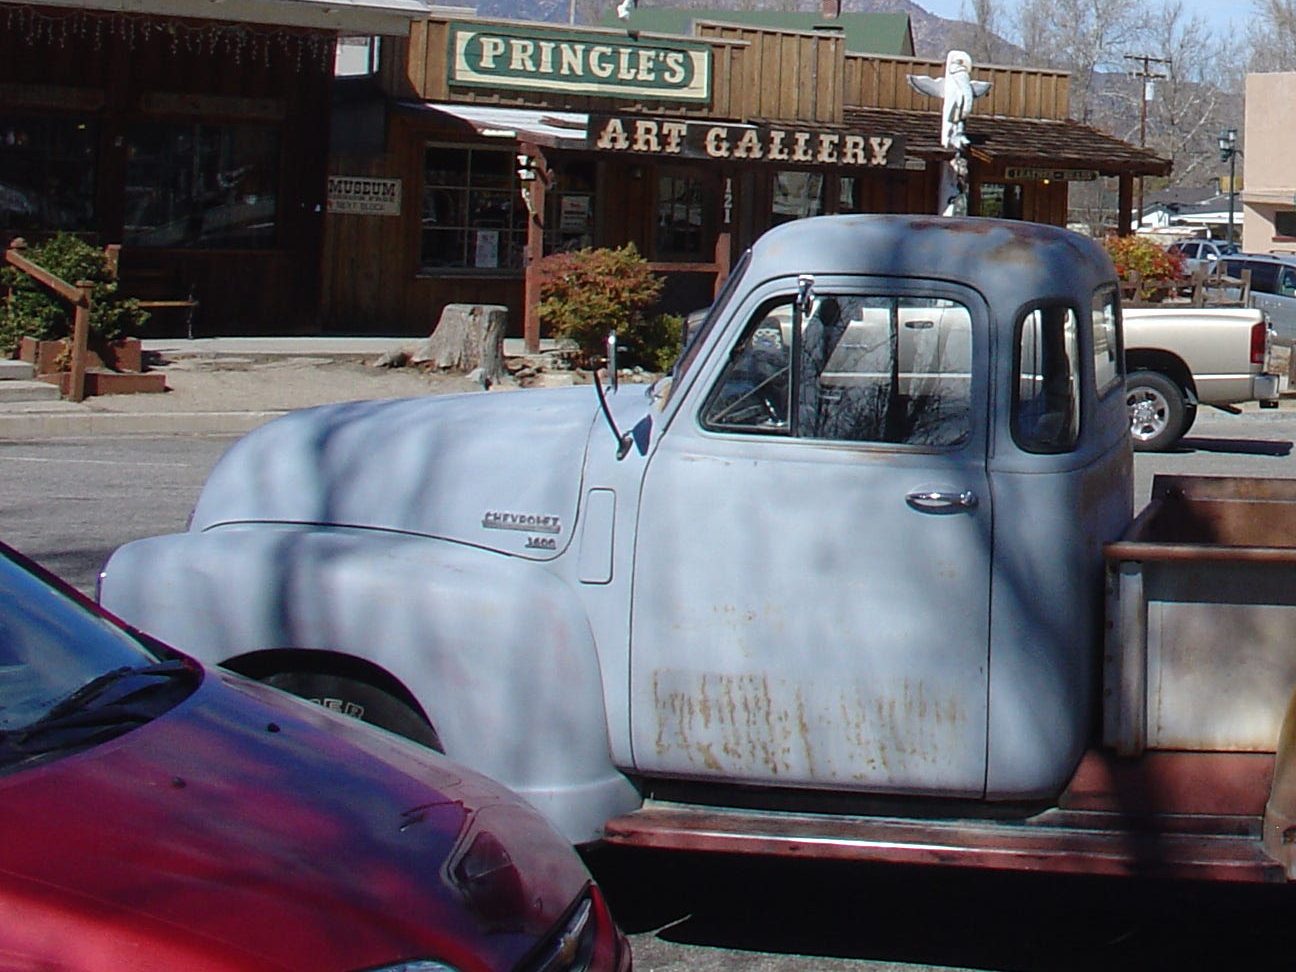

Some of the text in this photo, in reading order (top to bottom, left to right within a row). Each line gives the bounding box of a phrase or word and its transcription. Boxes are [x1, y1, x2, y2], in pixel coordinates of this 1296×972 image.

[479, 37, 685, 83] PRINGLE'S
[597, 118, 893, 166] ART GALLERY
[328, 179, 396, 197] MUSEUM
[723, 178, 733, 224] 121
[485, 512, 560, 527] CHEVROLET
